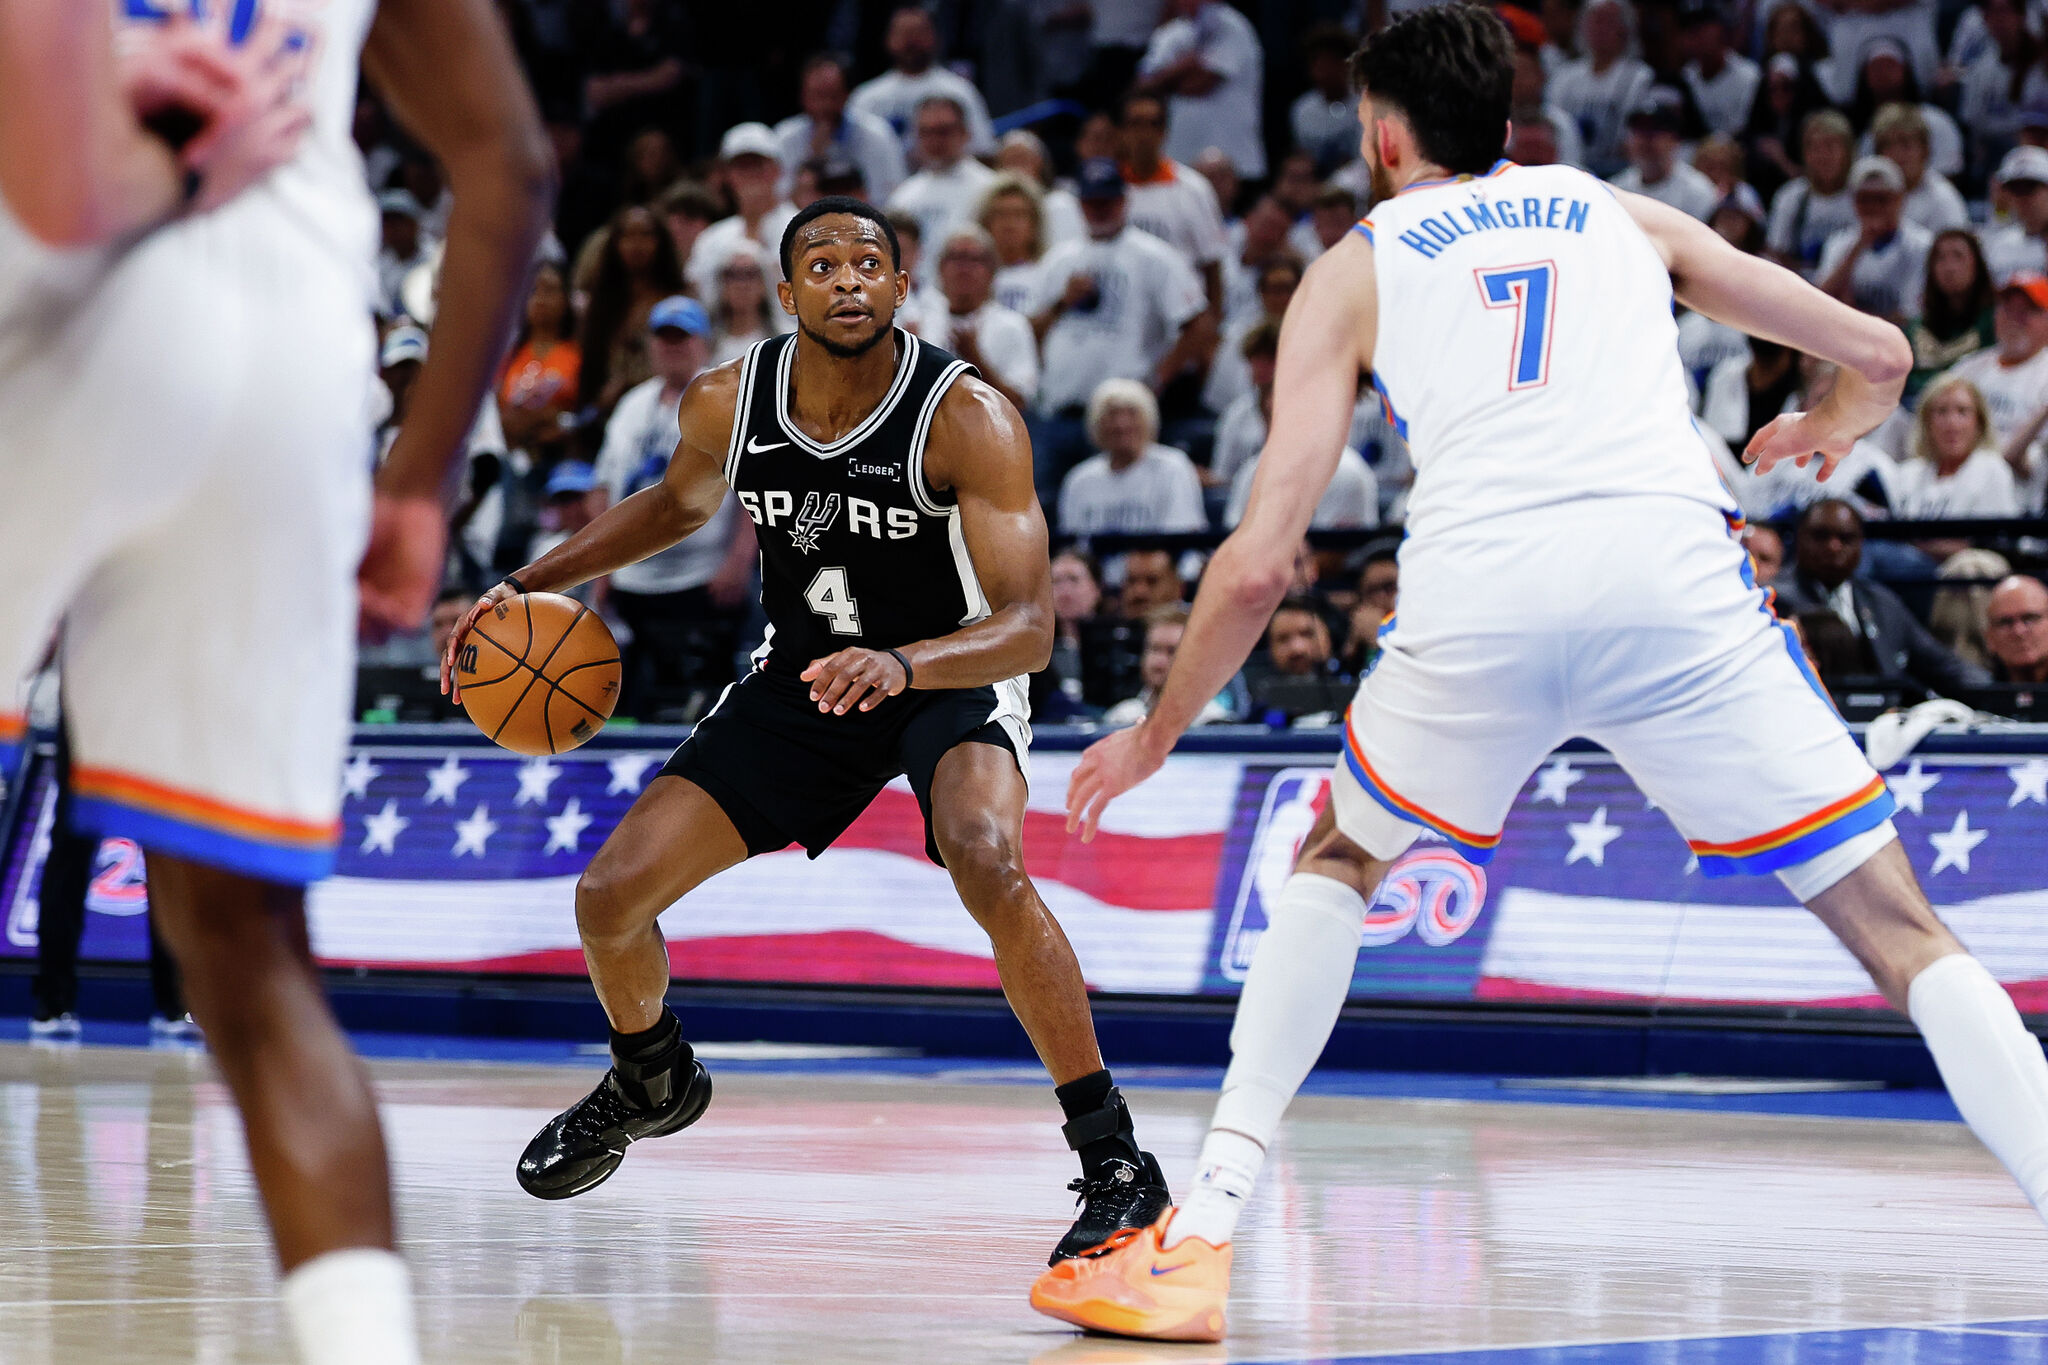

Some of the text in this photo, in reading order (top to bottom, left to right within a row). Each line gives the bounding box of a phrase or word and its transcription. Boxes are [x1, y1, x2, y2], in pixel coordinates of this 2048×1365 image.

[1398, 197, 1590, 259] HOLMGREN
[1473, 259, 1557, 392] 7
[855, 463, 894, 476] LEDGER
[737, 490, 918, 555] SPURS
[803, 566, 862, 636] 4
